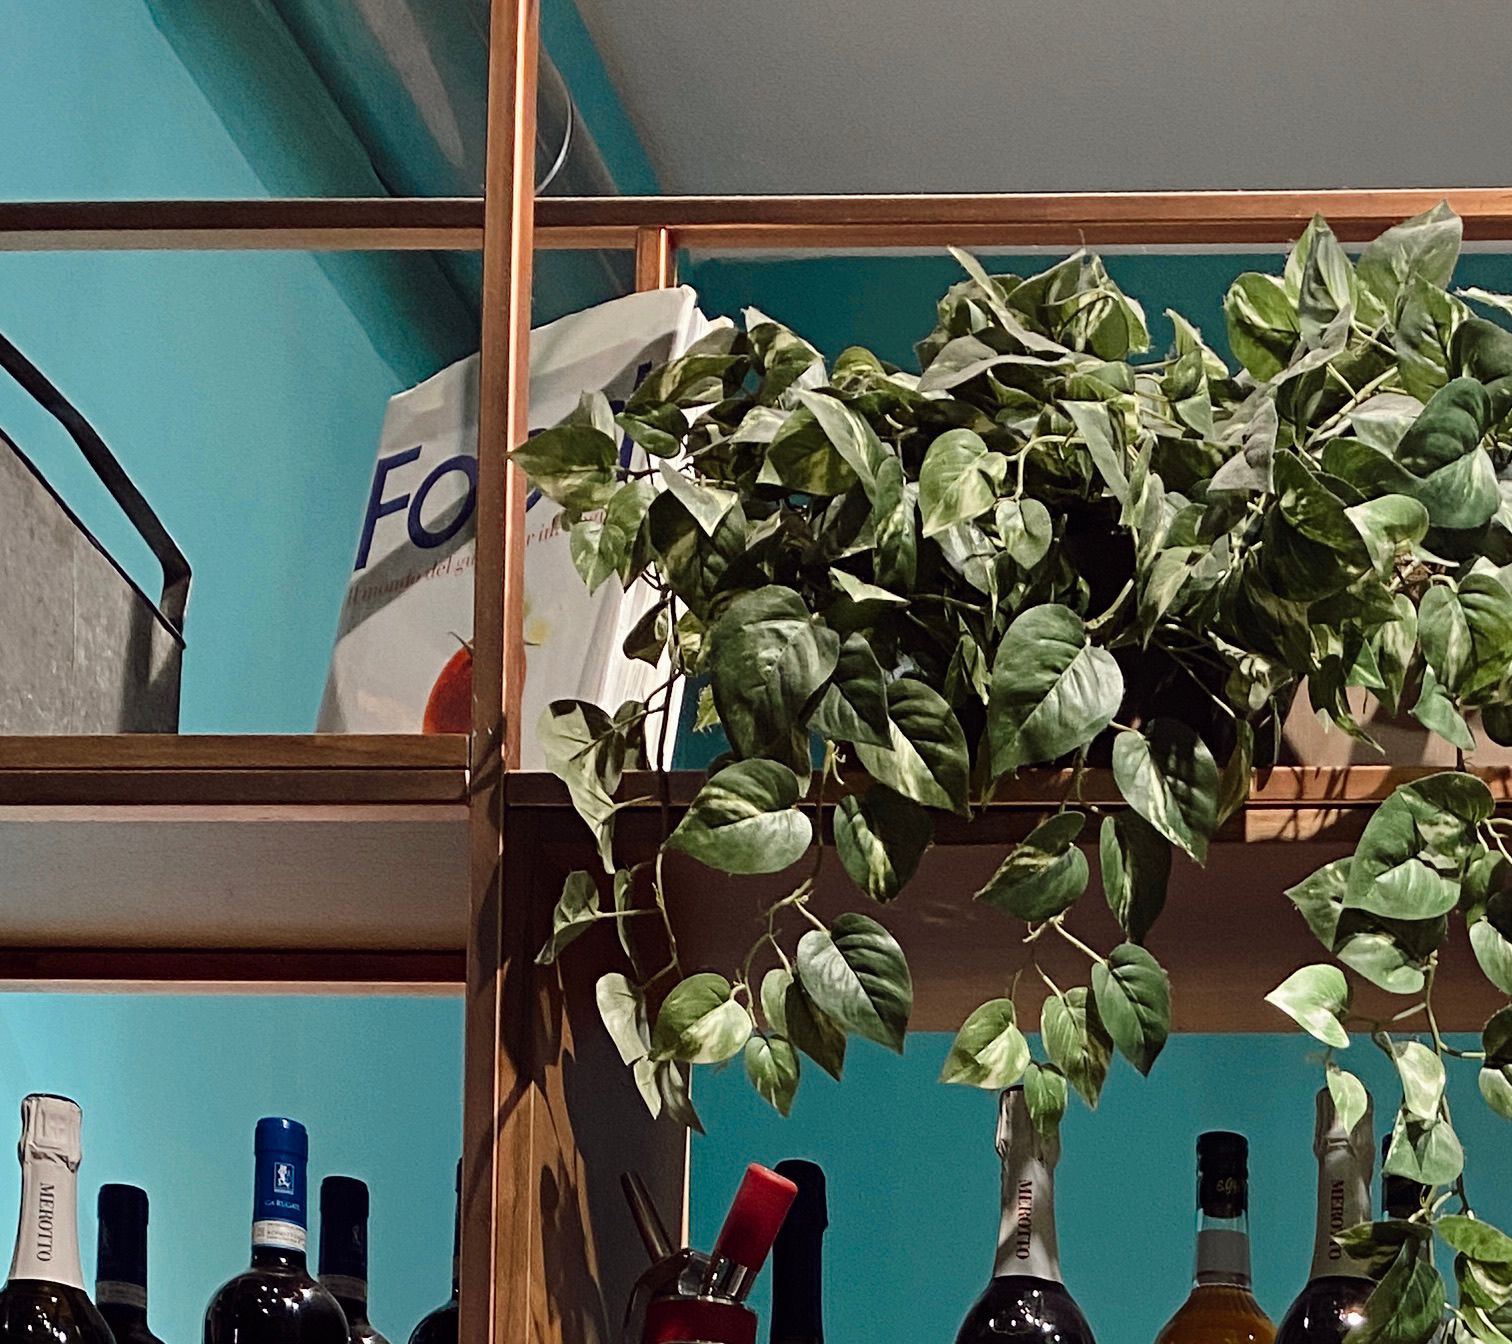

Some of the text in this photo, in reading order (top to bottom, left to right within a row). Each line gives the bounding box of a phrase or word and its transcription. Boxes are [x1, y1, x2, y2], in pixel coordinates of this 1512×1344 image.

[424, 555, 450, 579] del
[36, 1182, 55, 1263] MEROTTO
[1015, 1178, 1034, 1261] MEROTTO
